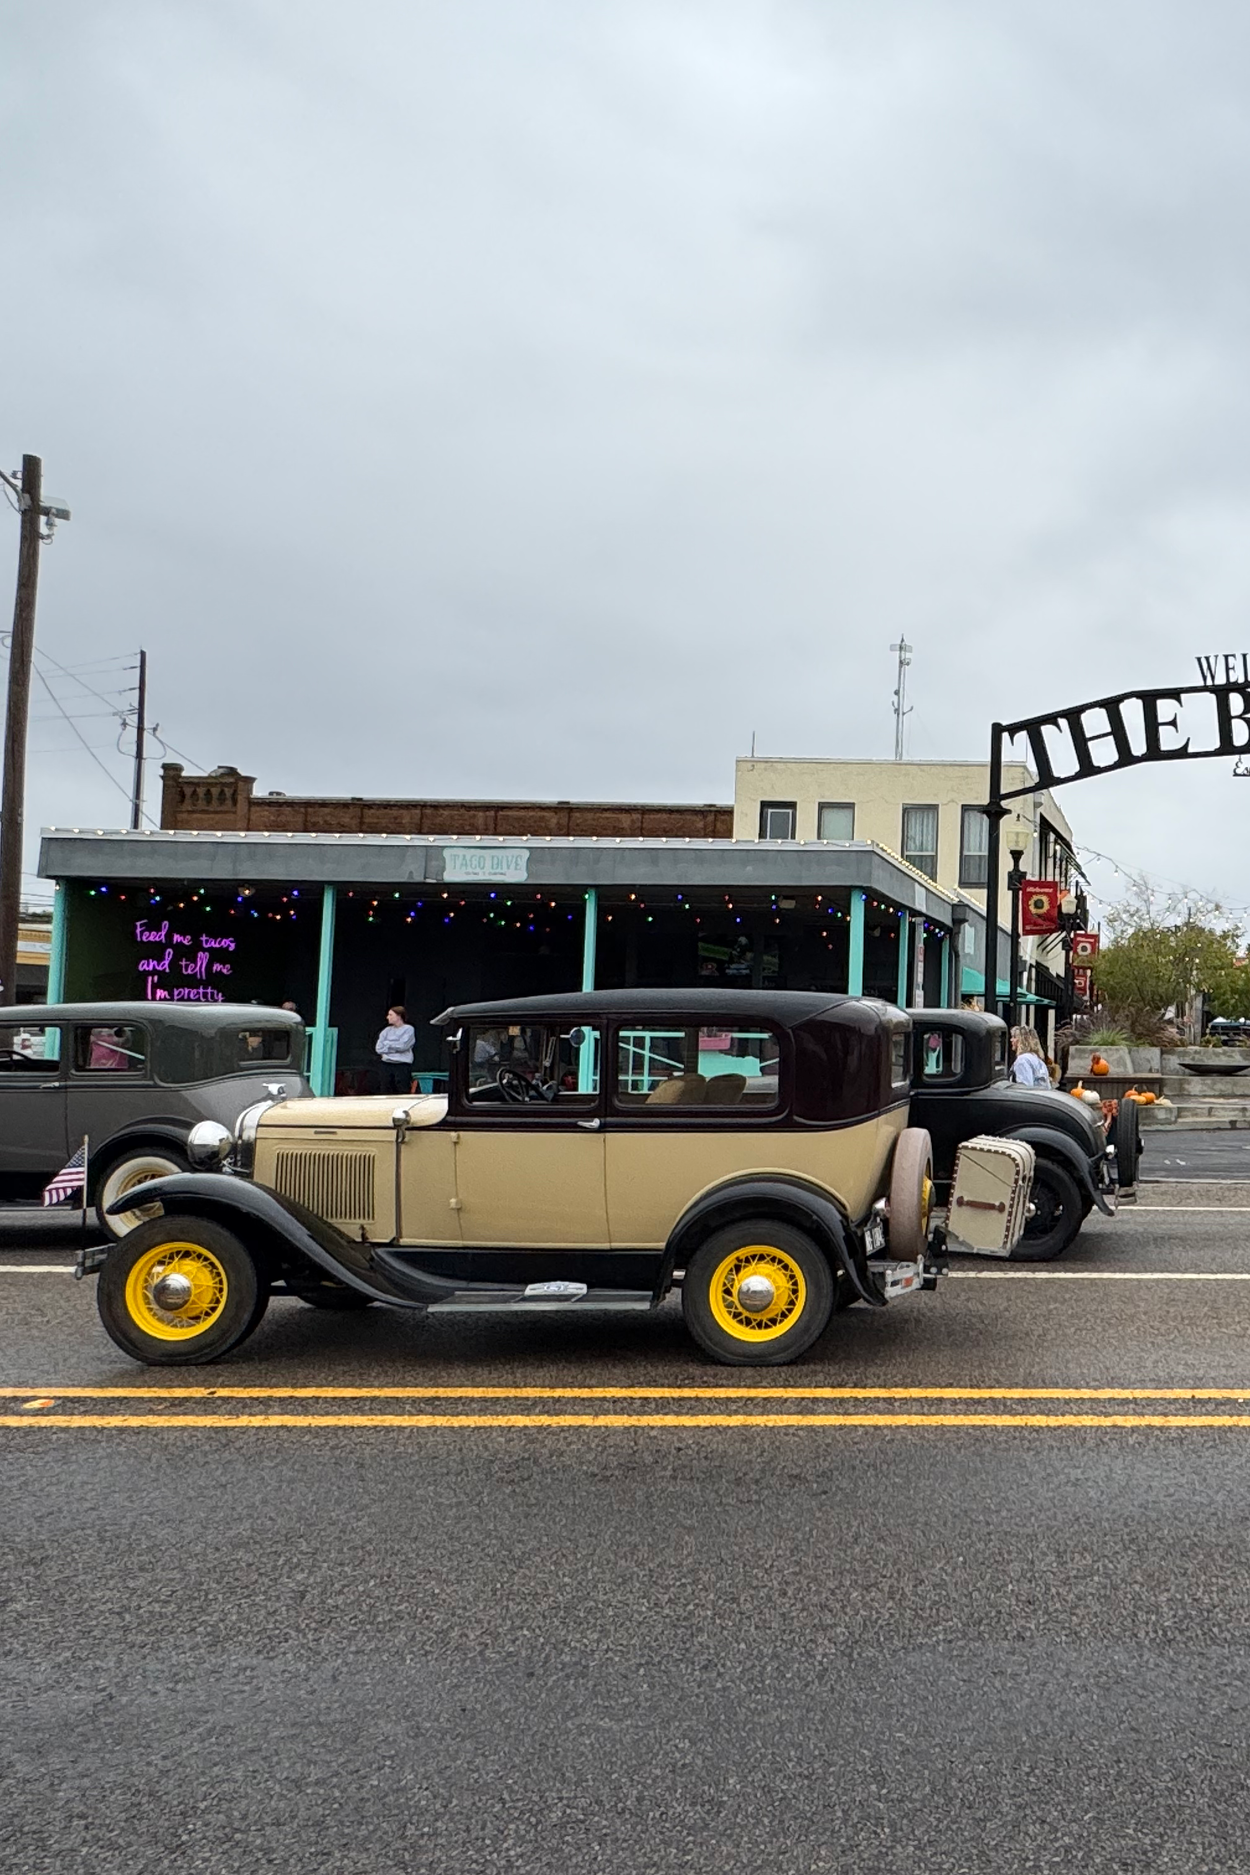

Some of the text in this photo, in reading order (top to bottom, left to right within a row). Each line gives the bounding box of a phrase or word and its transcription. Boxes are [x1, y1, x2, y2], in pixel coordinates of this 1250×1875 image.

[1009, 694, 1190, 788] THE
[451, 854, 523, 871] TACO DIVE
[136, 919, 236, 951] Feed me tacos
[138, 948, 233, 980] and tell me
[147, 975, 225, 1003] I'm pretty
